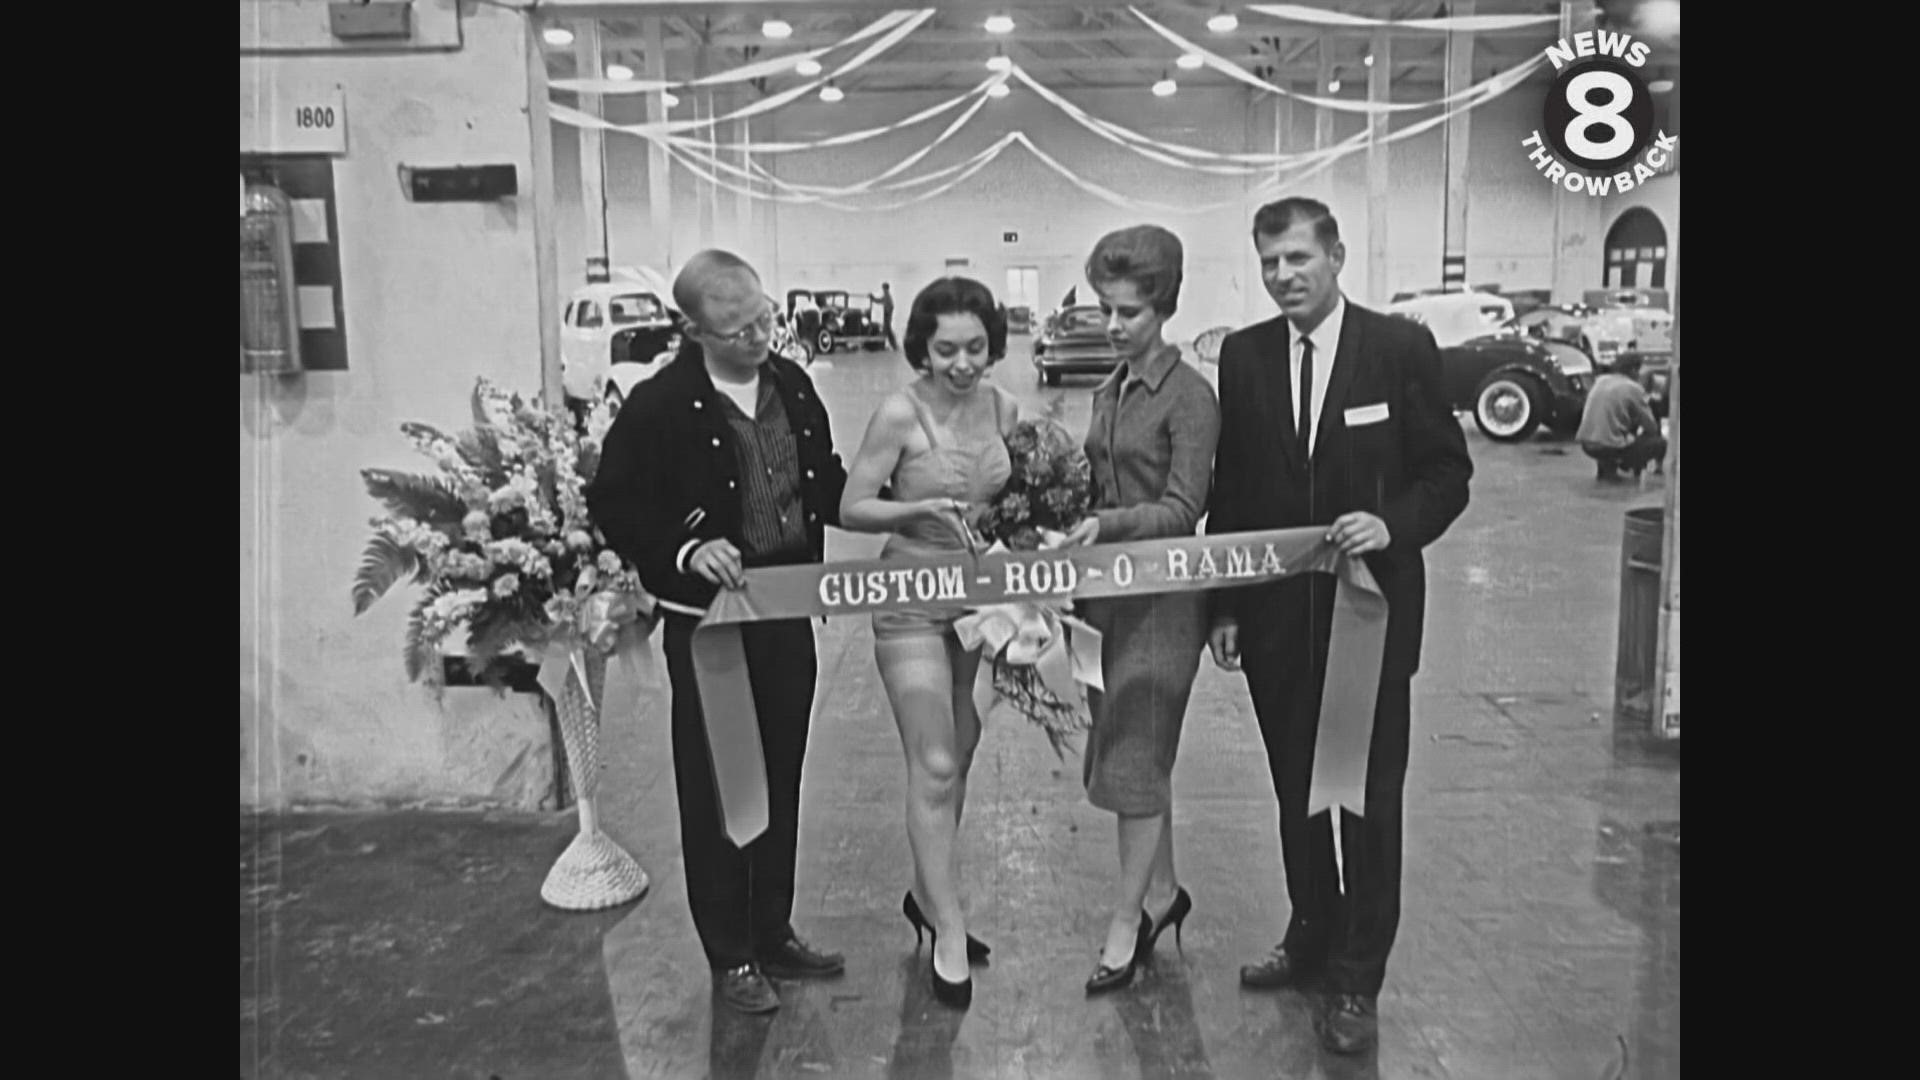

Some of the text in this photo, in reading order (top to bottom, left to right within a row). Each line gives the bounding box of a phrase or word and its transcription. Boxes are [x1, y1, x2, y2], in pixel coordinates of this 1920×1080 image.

[296, 106, 334, 128] 1800
[819, 565, 967, 606] CUSTOM
[1165, 543, 1287, 581] RAMA
